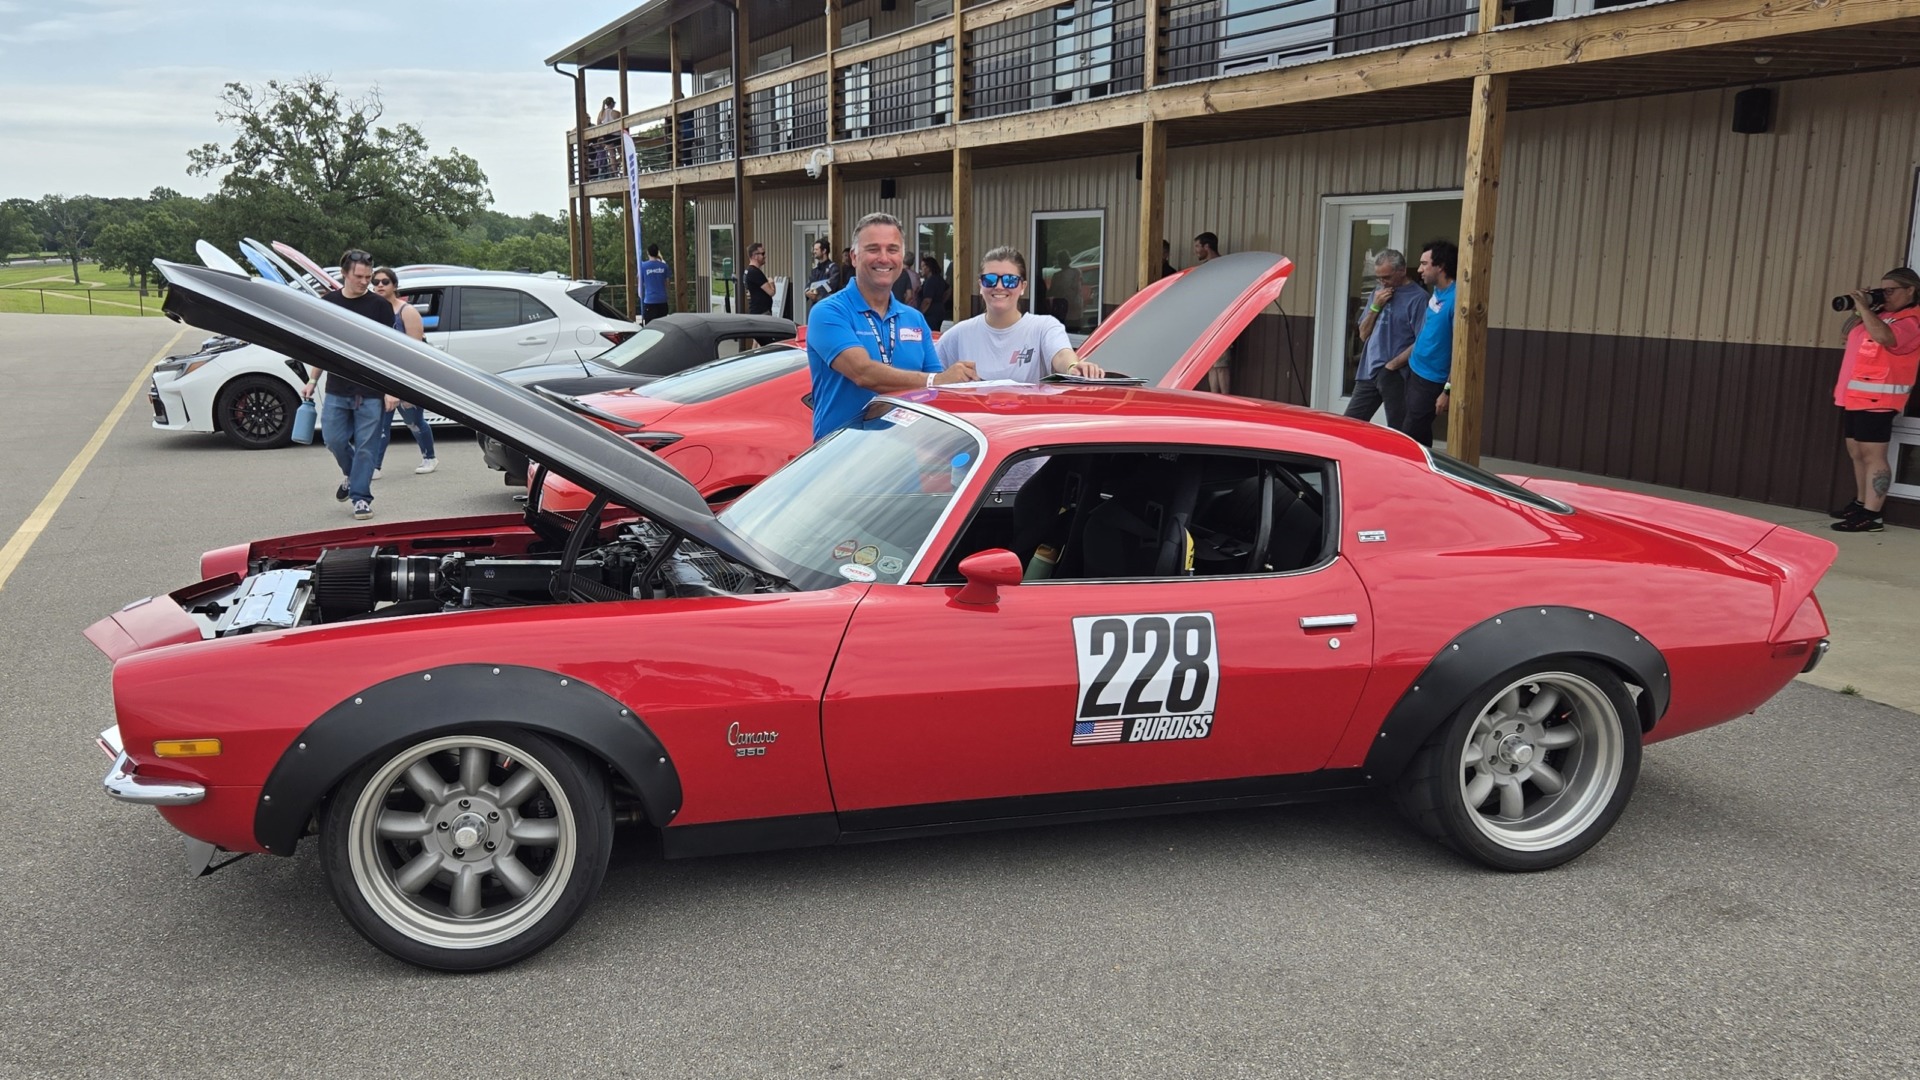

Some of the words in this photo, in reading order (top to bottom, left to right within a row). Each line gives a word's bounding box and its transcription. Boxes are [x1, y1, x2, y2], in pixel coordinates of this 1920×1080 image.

[1079, 615, 1212, 718] 228
[727, 721, 779, 746] Camaro
[1128, 714, 1213, 743] BURDISS
[735, 746, 767, 757] 350
